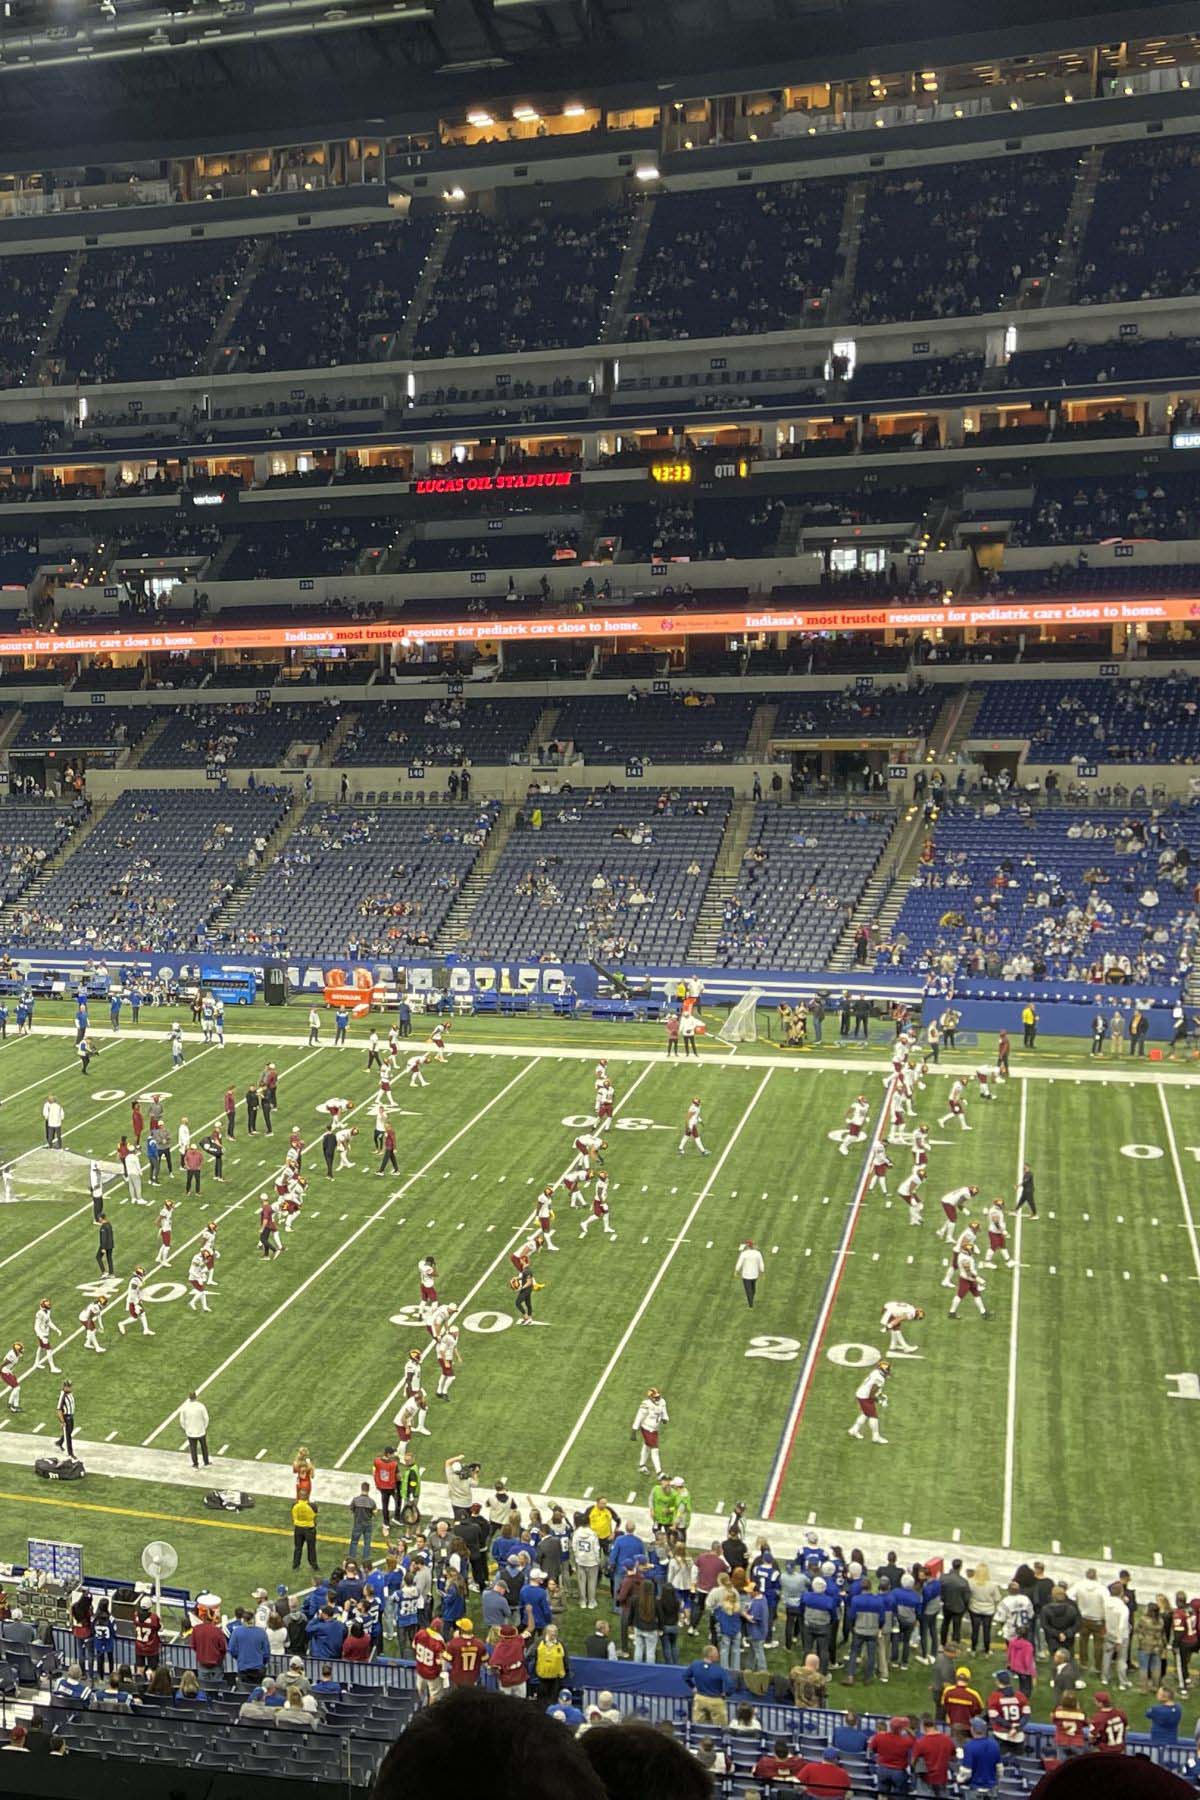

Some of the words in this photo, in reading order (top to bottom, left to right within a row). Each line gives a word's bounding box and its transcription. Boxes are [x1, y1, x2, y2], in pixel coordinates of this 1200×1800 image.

[714, 464, 736, 479] QTR
[416, 479, 464, 494] LUCAS
[467, 477, 493, 491] OIL
[496, 472, 573, 490] STADIUM
[193, 494, 223, 505] verizon
[745, 614, 803, 627] Indiana's
[806, 614, 838, 625] most
[841, 611, 886, 624] trusted
[888, 612, 944, 623] resource
[947, 608, 967, 621] for
[970, 607, 1029, 623] pediatric
[1032, 609, 1062, 619] care
[1065, 605, 1100, 618] close
[1103, 606, 1118, 617] to
[1121, 604, 1167, 616] home.
[285, 630, 334, 642] Indiana's
[336, 630, 363, 640] most
[366, 627, 404, 639] trusted
[407, 628, 454, 638] resource
[457, 626, 474, 636] for
[477, 623, 526, 638] pediatric
[530, 624, 554, 634] care
[557, 622, 585, 633] close
[588, 623, 601, 632] to
[604, 619, 641, 631] home.
[35, 639, 50, 650] for
[52, 638, 97, 651] pediatric
[99, 639, 121, 648] care
[123, 636, 149, 647] close
[151, 637, 162, 646] to
[164, 636, 196, 646] home.
[409, 768, 424, 777] 140
[578, 1540, 591, 1553] 53
[135, 1626, 152, 1643] 17
[415, 1643, 435, 1667] 98
[461, 1652, 478, 1671] 17
[1001, 1705, 1021, 1721] 19
[1105, 1722, 1125, 1746] 17
